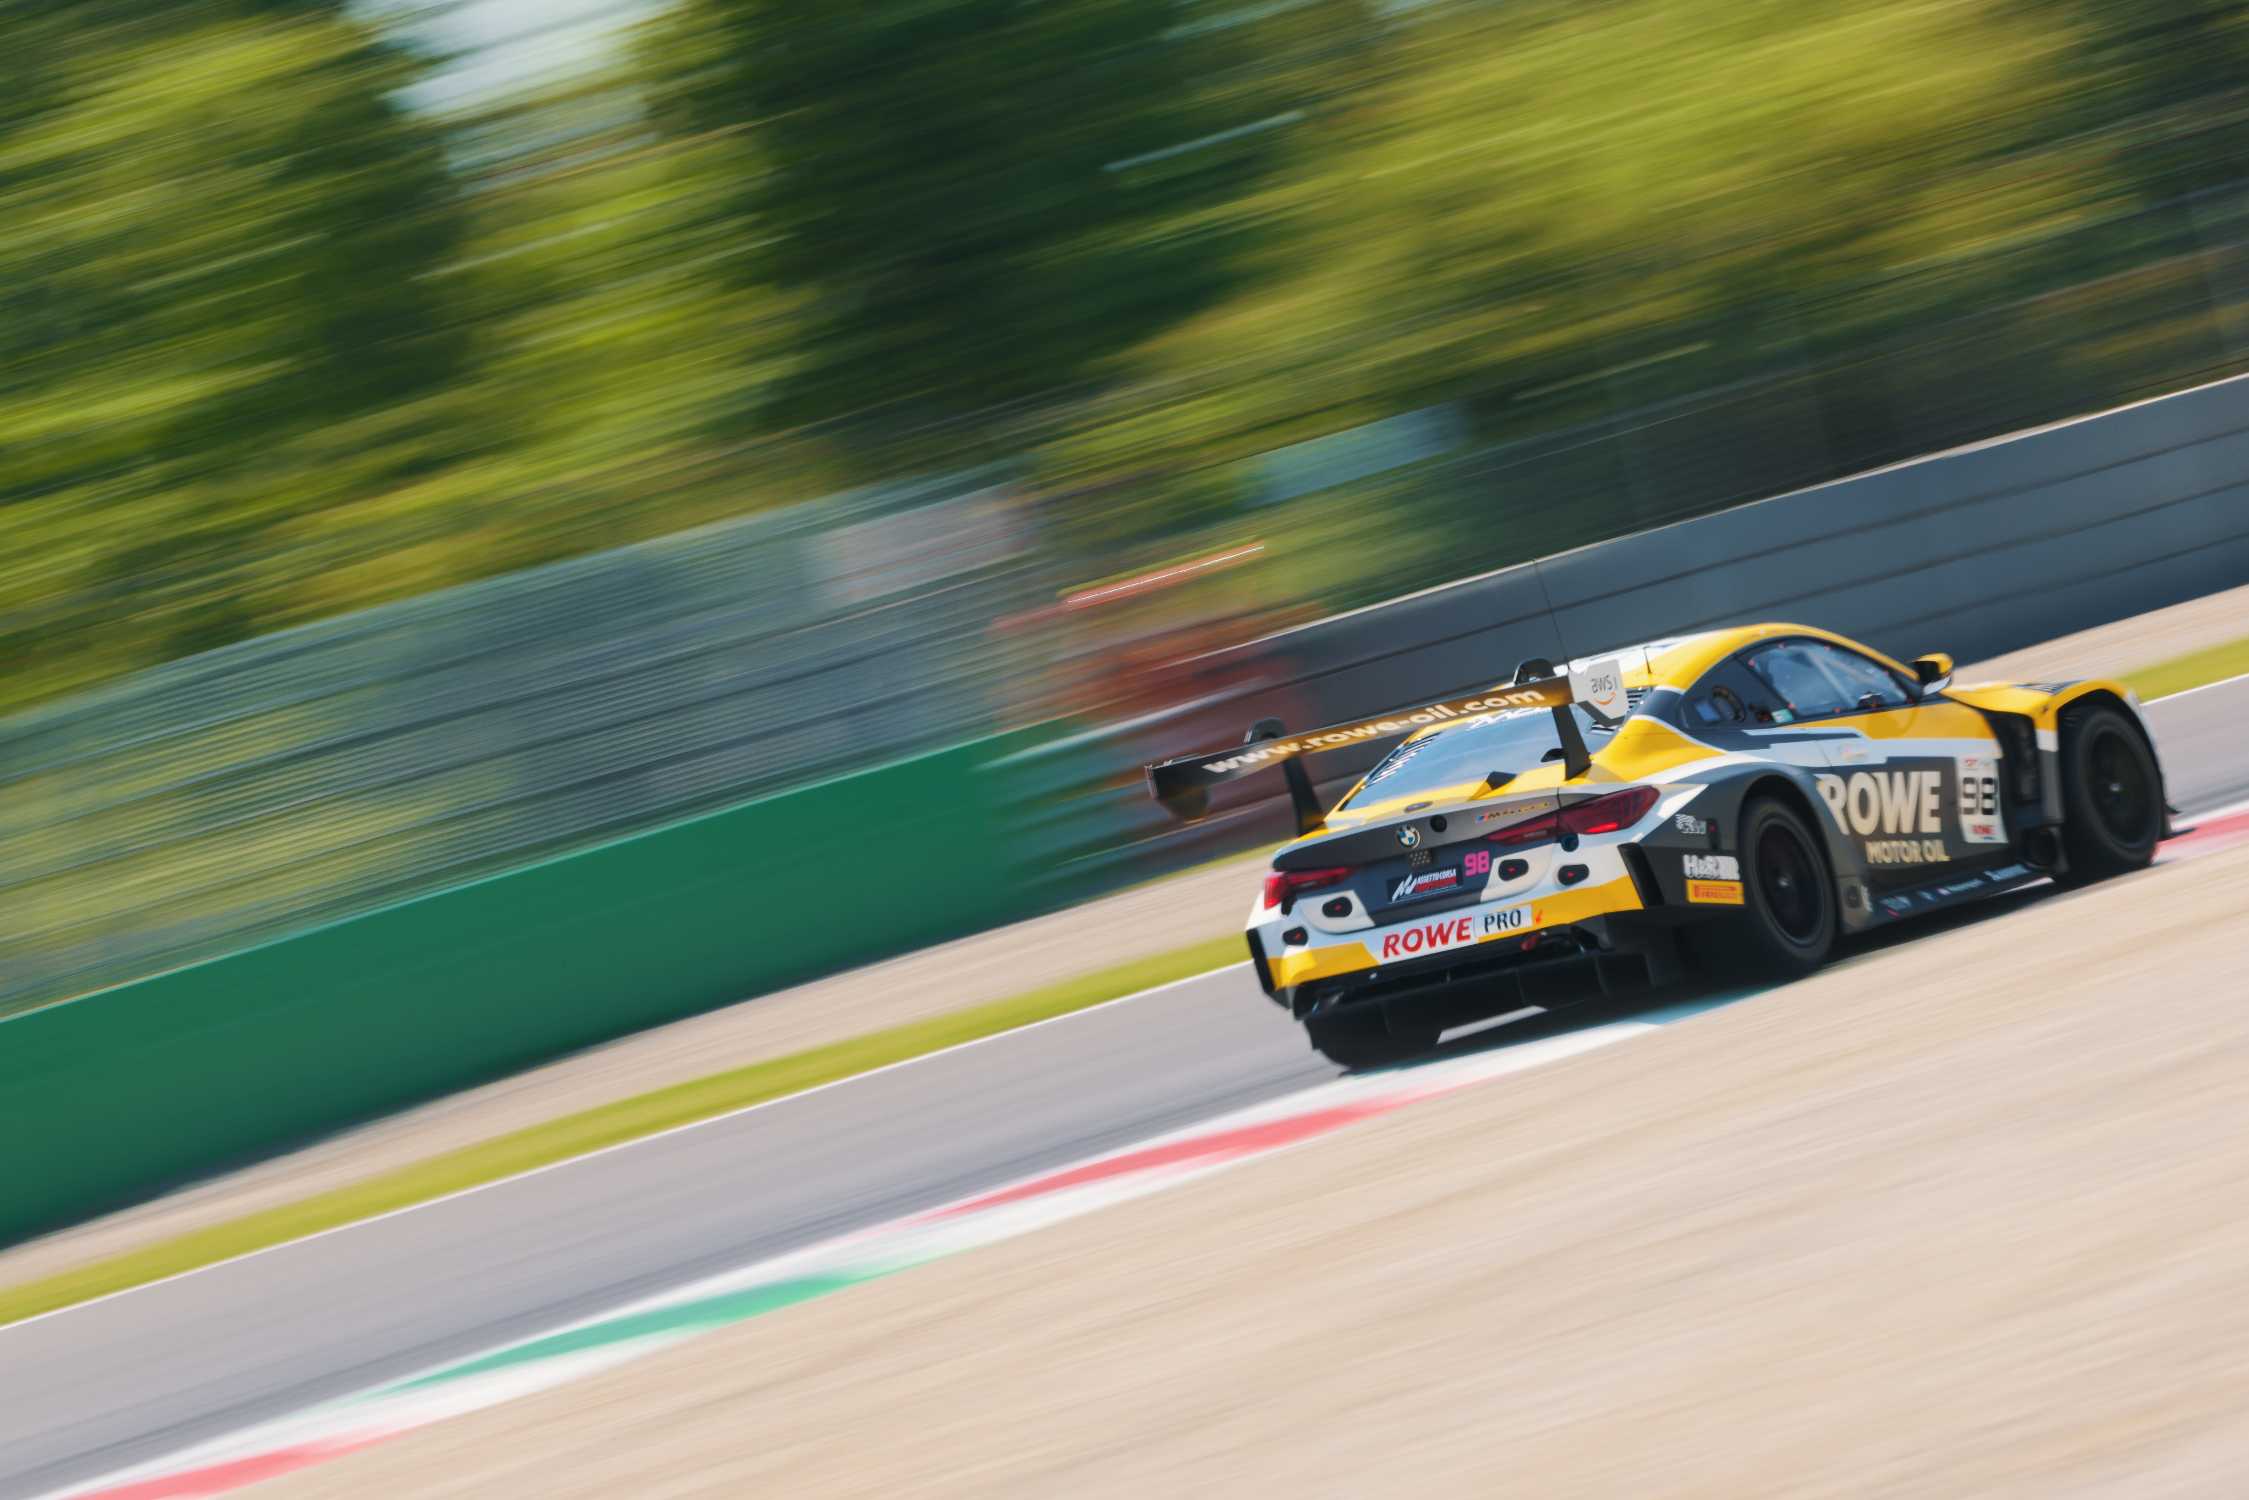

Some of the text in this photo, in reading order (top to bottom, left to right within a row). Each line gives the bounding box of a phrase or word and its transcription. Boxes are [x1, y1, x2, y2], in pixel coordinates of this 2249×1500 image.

[1202, 689, 1545, 773] www.rowe-oil.com
[1814, 771, 1941, 835] ROWE
[1464, 851, 1489, 877] 98
[1865, 839, 1951, 864] MOTOR OIL
[1382, 909, 1522, 959] ROWE PRO
